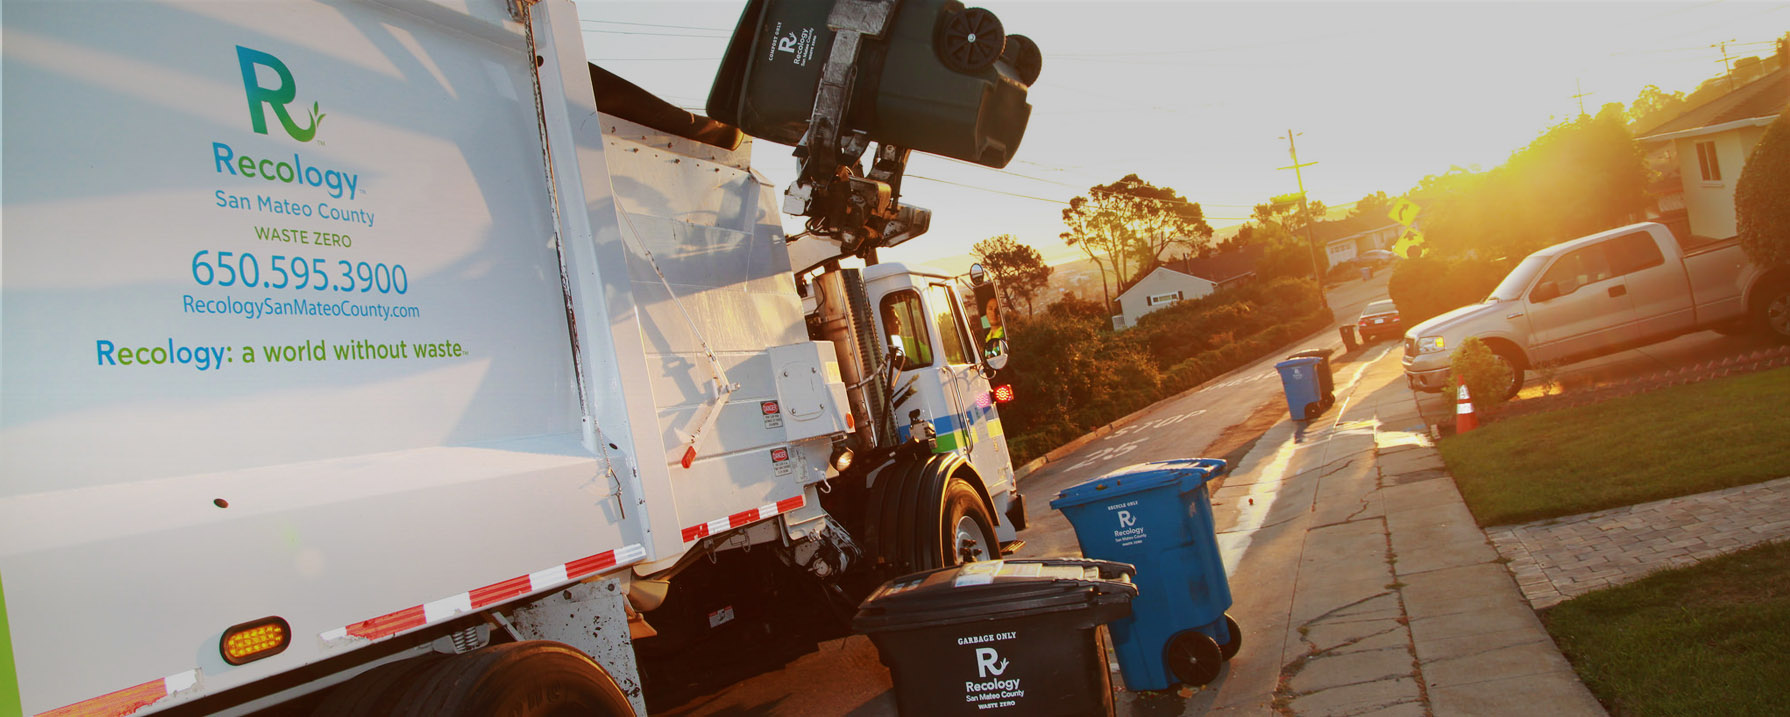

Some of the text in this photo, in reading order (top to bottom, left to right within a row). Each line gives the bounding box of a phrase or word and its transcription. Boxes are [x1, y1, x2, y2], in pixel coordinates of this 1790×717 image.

[793, 28, 808, 64] Recology
[212, 142, 358, 200] Recology
[215, 190, 374, 227] San Mateo County
[254, 226, 352, 248] WASTE ZERO
[192, 250, 408, 295] 650.595.3900
[183, 295, 420, 321] RecologySanMateoCounty.com
[96, 338, 233, 371] Recology:
[242, 345, 255, 362] a
[262, 340, 326, 362] world
[332, 339, 408, 361] without
[1104, 409, 1207, 440] STOP
[1114, 527, 1144, 537] Recology
[957, 631, 1016, 645] GARBAGE ONLY
[965, 677, 1020, 692] Recology
[966, 689, 1025, 702] San Mateo County
[978, 702, 999, 710] WASTE
